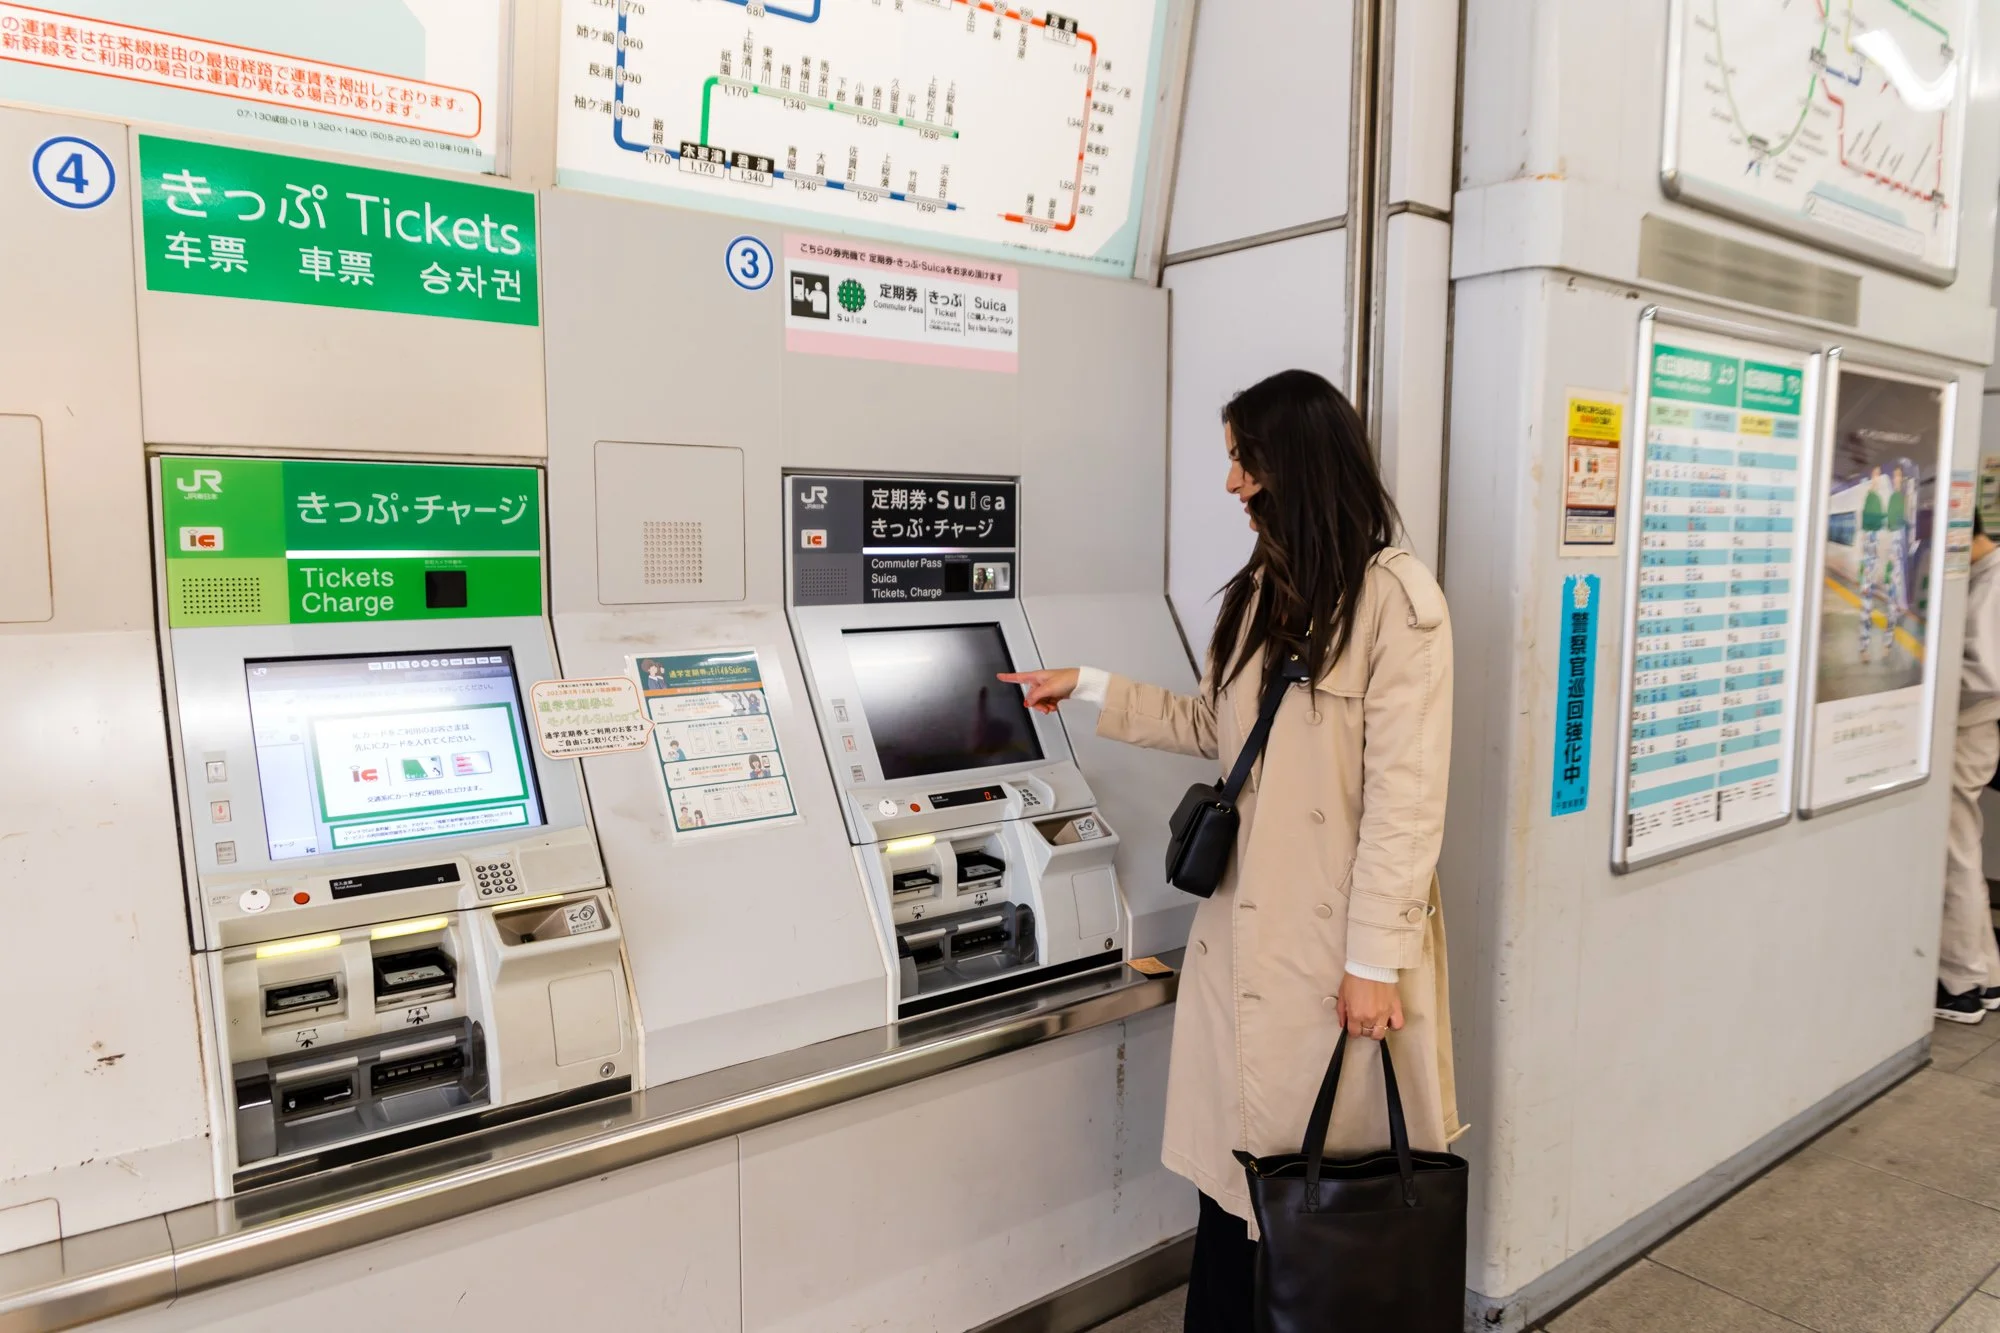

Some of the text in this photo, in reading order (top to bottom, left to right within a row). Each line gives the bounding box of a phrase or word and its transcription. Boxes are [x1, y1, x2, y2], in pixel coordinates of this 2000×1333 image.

[625, 1, 645, 15] 770
[746, 4, 765, 18] 680
[623, 36, 643, 50] 860
[2, 16, 465, 113] の運賃表は在来線経由の最短経路で運賃を掲出しております。
[2, 32, 422, 120] 新幹線をご利用の場合は運賃が異なる場合があります。
[621, 71, 642, 85] 990
[619, 106, 641, 120] 990
[56, 152, 89, 194] 4
[160, 168, 521, 257] きっぷ Tickets
[164, 231, 376, 288] 车票 車票
[740, 246, 760, 280] 3
[419, 260, 522, 304] 승차권
[880, 283, 918, 302] 定期券
[928, 290, 962, 308] きっぷ
[934, 307, 957, 319] Ticket
[974, 296, 1007, 313] Suica
[837, 312, 868, 326] Suica
[176, 469, 224, 494] JR
[801, 485, 828, 504] JR
[297, 491, 528, 526] きっぷ・チャージ
[871, 517, 994, 539] きっぷ・チャージ
[871, 558, 919, 570] Commuter
[920, 557, 942, 569] Pass
[299, 567, 395, 589] Tickets
[871, 572, 897, 584] Suica
[872, 586, 942, 600] Tickets, Charge
[301, 591, 395, 617] Charge
[1563, 611, 1589, 785] 警察官巡回強化中
[544, 724, 645, 740] 通学定期券をご利用のお客さま
[983, 791, 991, 801] 0
